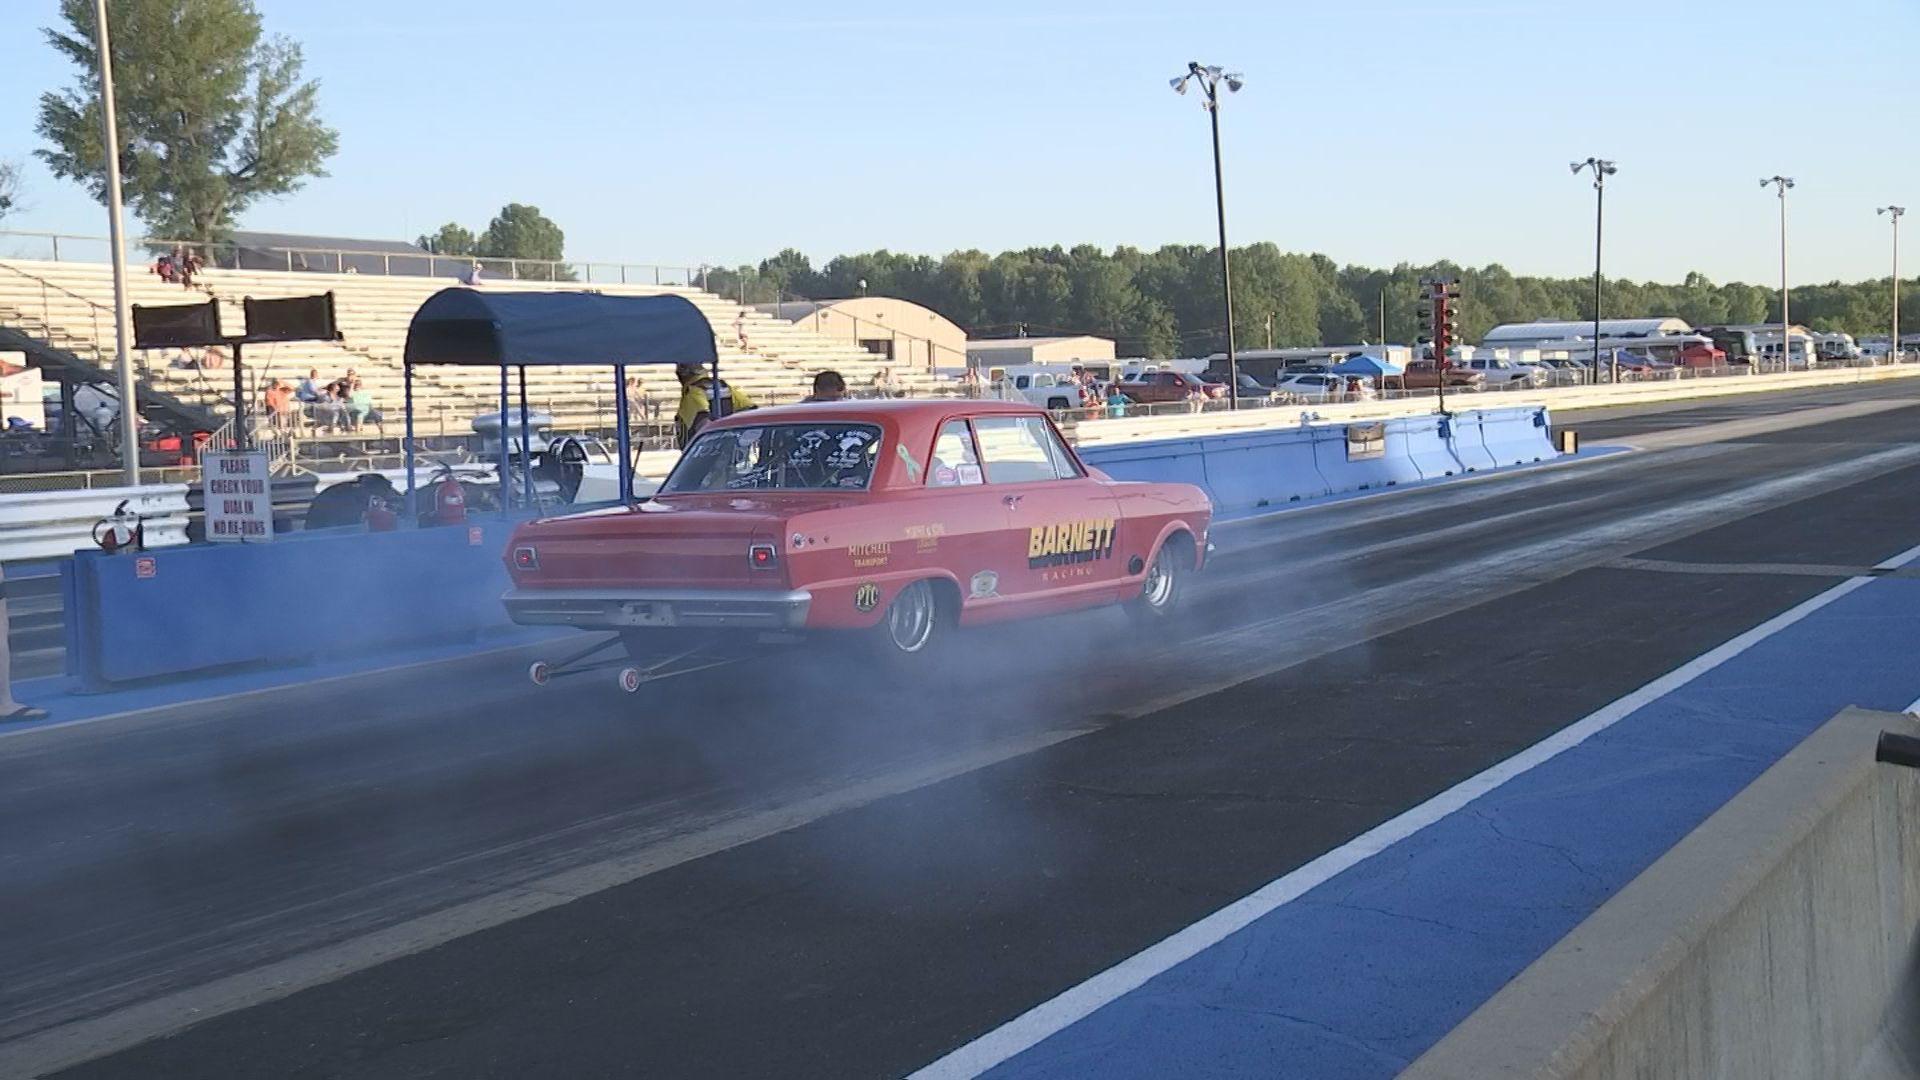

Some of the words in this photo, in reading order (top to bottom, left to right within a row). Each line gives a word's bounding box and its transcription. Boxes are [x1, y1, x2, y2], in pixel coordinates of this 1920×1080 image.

[220, 459, 250, 473] PLEASE
[211, 479, 239, 494] CHECK
[241, 479, 265, 494] YOUR
[223, 499, 243, 514] DIAL
[244, 500, 254, 514] IN
[214, 520, 226, 535] NO
[227, 520, 265, 535] RE-RUNS
[1028, 517, 1116, 562] BARNETT
[1041, 566, 1092, 581] RACING
[856, 582, 879, 606] PTC
